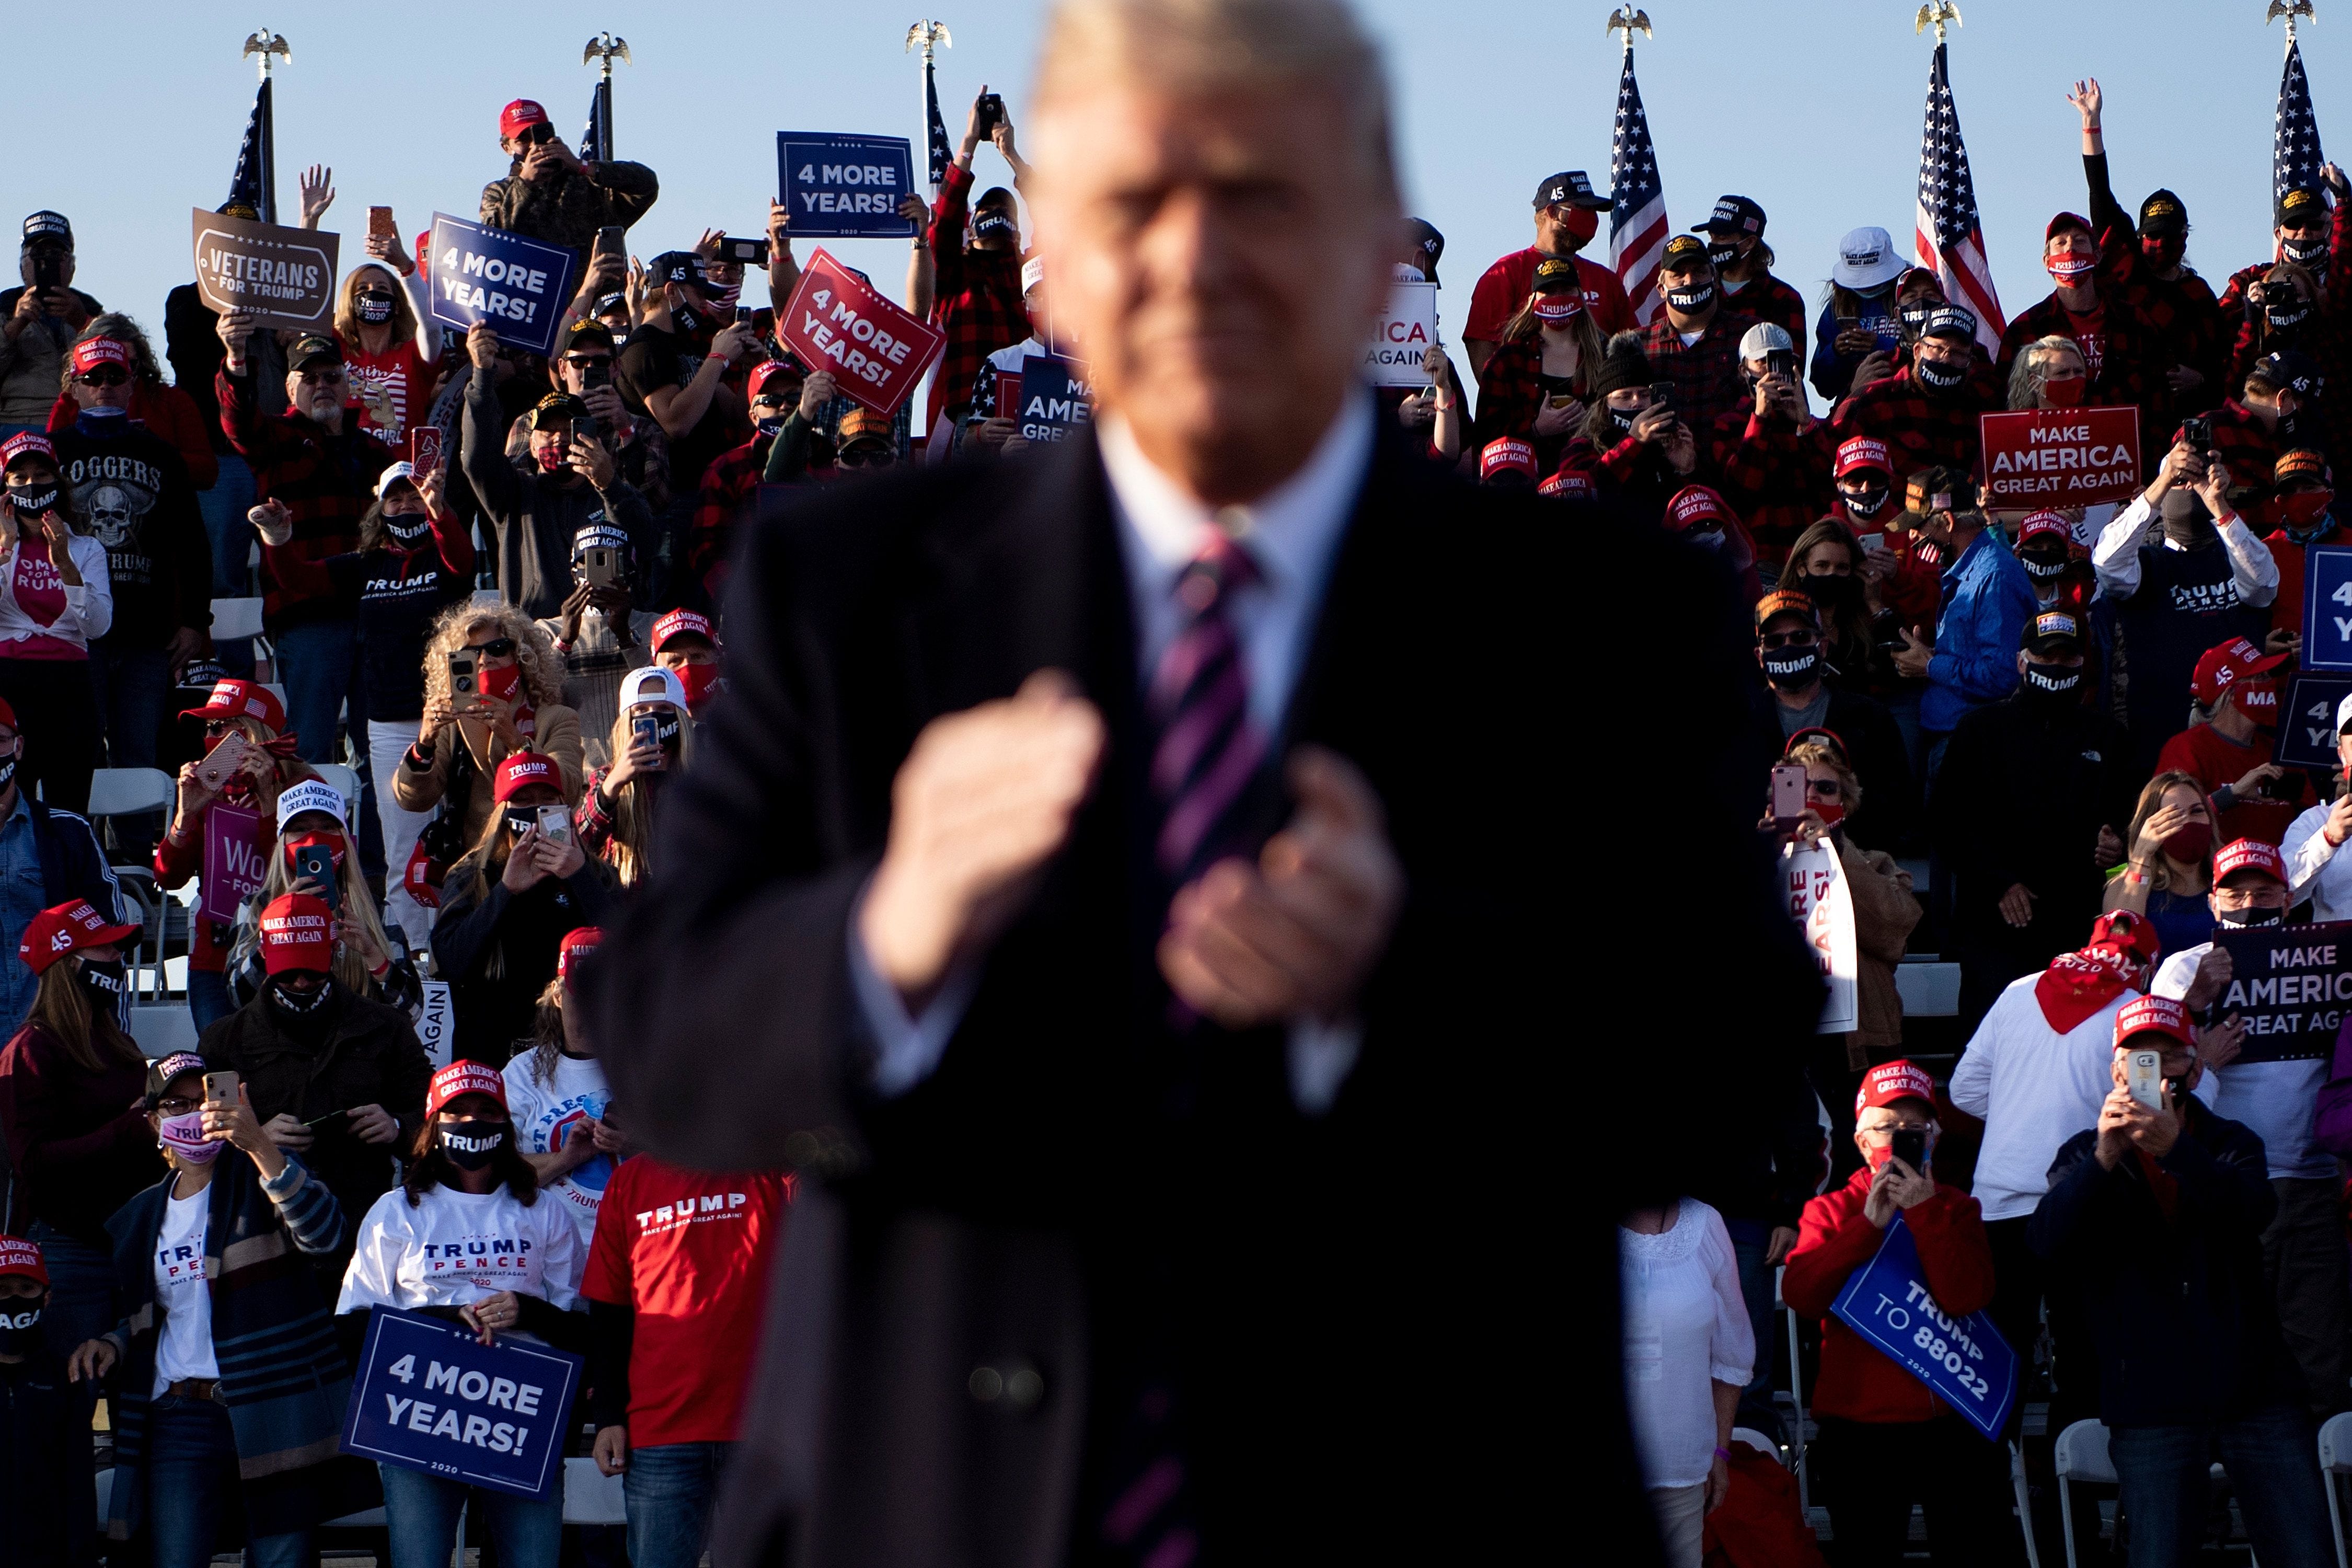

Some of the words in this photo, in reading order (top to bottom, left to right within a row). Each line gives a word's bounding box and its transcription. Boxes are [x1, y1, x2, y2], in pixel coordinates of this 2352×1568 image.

[798, 164, 815, 183] 4
[822, 165, 896, 186] MORE
[801, 192, 895, 213] YEARS!
[1551, 186, 1564, 201] 45
[1424, 239, 1437, 252] 45
[2284, 244, 2324, 259] TRUMP
[211, 248, 319, 289] VETERANS
[442, 247, 458, 269] 4
[463, 252, 547, 294] MORE
[2055, 260, 2086, 269] TRUMP
[670, 267, 686, 281] 45
[220, 276, 246, 293] FOR
[252, 283, 305, 300] TRUMP
[1671, 287, 1712, 305] TRUMP
[361, 297, 390, 312] Trump
[442, 276, 537, 324] YEARS!
[1541, 303, 1574, 314] TRUMP
[1931, 308, 1949, 319] MAKE
[1950, 308, 1975, 325] AMERICA
[1932, 317, 1953, 327] GREAT
[1953, 319, 1971, 332] AGAIN
[2270, 309, 2308, 326] TRUMP
[812, 289, 832, 310] 4
[830, 301, 911, 365] MORE
[78, 341, 98, 354] MAKE
[83, 350, 105, 362] GREAT
[803, 310, 893, 388] YEARS!
[1922, 365, 1962, 386] TRUMP
[2292, 376, 2310, 391] 45
[373, 429, 403, 443] GIRL
[2030, 425, 2090, 444] MAKE
[1484, 444, 1503, 459] MAKE
[1503, 441, 1531, 455] AMERICA
[1839, 442, 1858, 457] MAKE
[1844, 451, 1864, 465] GREAT
[1865, 451, 1884, 461] AGAIN
[1488, 453, 1508, 467] GREAT
[1509, 453, 1528, 464] AGAIN
[1992, 444, 2133, 474] AMERICA
[1555, 478, 1586, 490] AMERICA
[1993, 476, 2061, 494] GREAT
[2068, 470, 2134, 490] AGAIN
[11, 490, 57, 509] TRUMP
[1846, 489, 1889, 513] TRUMP
[1678, 504, 1698, 520] GREAT
[2023, 513, 2043, 524] MAKE
[387, 521, 430, 538] TRUMP
[577, 526, 594, 540] MAKE
[595, 525, 628, 541] AMERICA
[2027, 521, 2048, 533] GREAT
[579, 537, 600, 550] GREAT
[28, 570, 50, 579] FOR
[2022, 558, 2065, 576] TRUMP
[366, 572, 437, 590] TRUMP
[2170, 577, 2237, 599] TRUMP
[2176, 592, 2237, 607] PENCE
[655, 614, 675, 631] MAKE
[675, 612, 708, 627] AMERICA
[660, 622, 683, 639] GREAT
[684, 621, 706, 633] AGAIN
[188, 665, 203, 676] MAKE
[1767, 654, 1815, 673] TRUMP
[190, 673, 209, 684] GREAT
[2030, 671, 2079, 691] TRUMP
[2216, 665, 2233, 686] 45
[2307, 701, 2330, 720] 4
[509, 763, 547, 776] TRUMP
[282, 788, 303, 802] MAKE
[304, 786, 340, 802] AMERICA
[286, 798, 311, 813] GREAT
[312, 798, 337, 810] AGAIN
[2216, 844, 2238, 863] MAKE
[2220, 853, 2246, 873] GREAT
[2246, 854, 2272, 867] AGAIN
[234, 879, 260, 894] FOR
[264, 917, 286, 931] MAKE
[287, 916, 325, 928] AMERICA
[52, 929, 72, 951] 45
[270, 931, 294, 945] GREAT
[296, 930, 321, 943] AGAIN
[2270, 945, 2337, 969] MAKE
[2054, 961, 2102, 972] 2020
[2222, 973, 2352, 1008] AMERIC
[2119, 1000, 2144, 1019] MAKE
[2143, 999, 2183, 1018] AMERICA
[424, 989, 447, 1054] AGAIN
[2123, 1012, 2152, 1031] GREAT
[2152, 1012, 2180, 1028] AGAIN
[435, 1067, 460, 1087] MAKE
[461, 1065, 501, 1083] AMERICA
[1873, 1066, 1900, 1082] MAKE
[441, 1078, 469, 1097] GREAT
[472, 1078, 497, 1093] AGAIN
[1877, 1078, 1908, 1094] GREAT
[442, 1131, 502, 1152] TRUMP
[637, 1193, 746, 1227] TRUMP
[662, 1219, 691, 1232] AMERICA
[424, 1239, 532, 1258] TRUMP
[8, 1253, 37, 1265] AGAIN
[435, 1256, 526, 1271] PENCE
[1907, 1279, 1985, 1361] TRUMP
[1874, 1293, 1910, 1330] TO
[1913, 1326, 1989, 1402] 88022
[1907, 1358, 1930, 1378] 2020
[389, 1354, 417, 1383] 4
[424, 1361, 544, 1417] MORE
[385, 1393, 529, 1457] YEARS!
[432, 1461, 458, 1473] 2020
